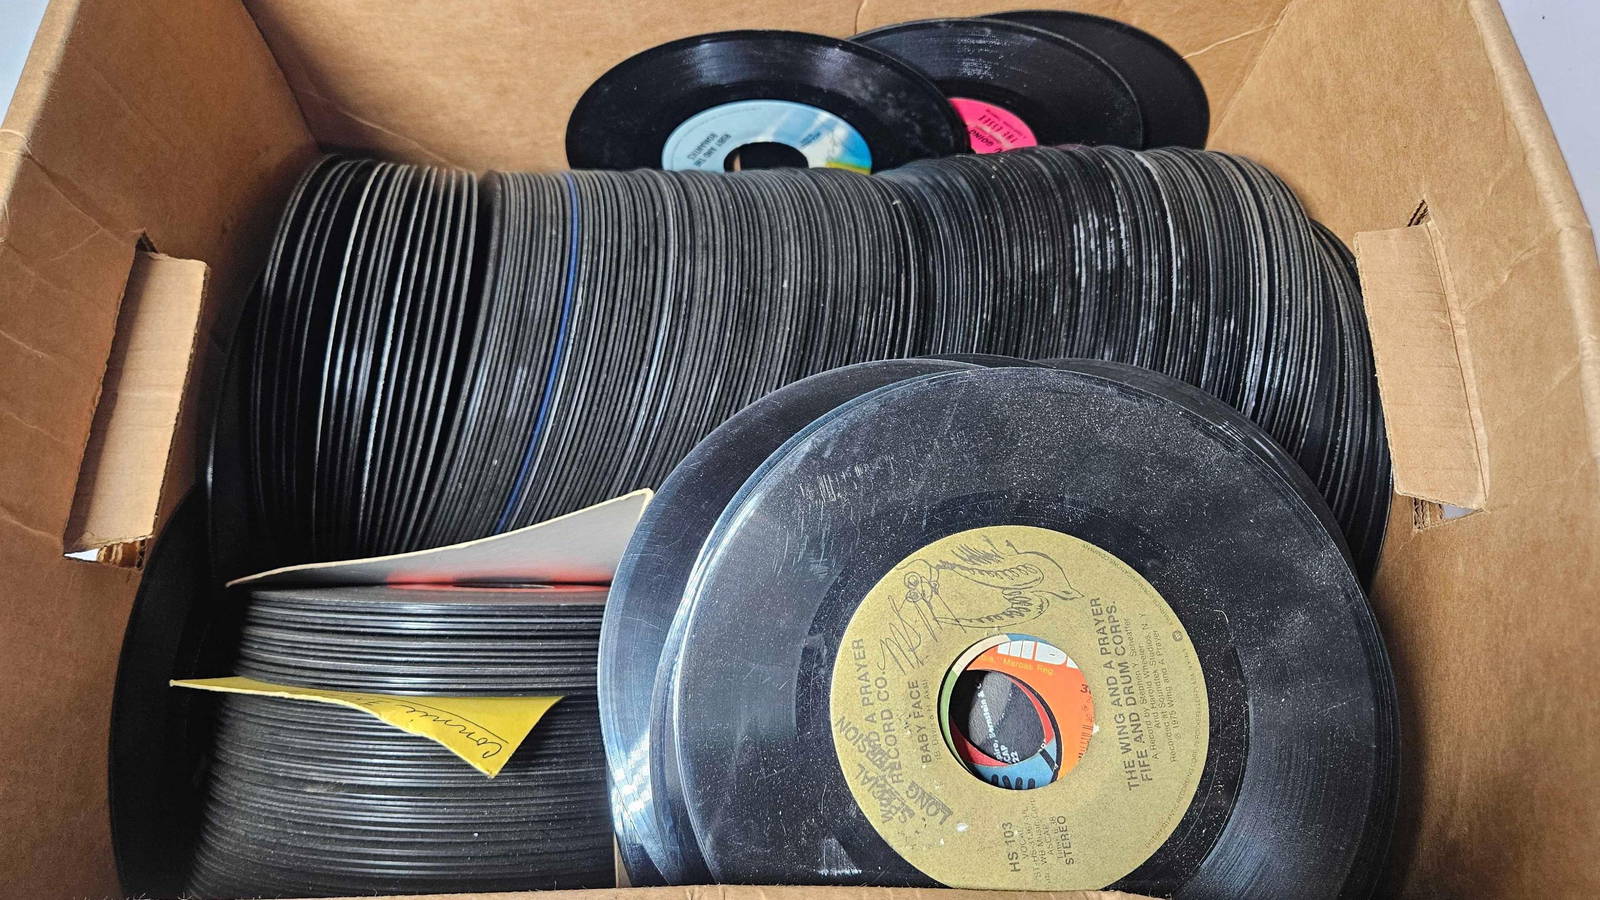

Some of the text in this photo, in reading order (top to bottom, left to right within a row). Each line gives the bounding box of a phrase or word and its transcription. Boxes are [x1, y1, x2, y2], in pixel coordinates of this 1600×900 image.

[1153, 630, 1163, 656] Prayer
[852, 638, 874, 706] PRAYER
[1136, 670, 1148, 705] Stephen
[1152, 670, 1166, 708] Soundtek
[1161, 668, 1170, 683] and
[1090, 597, 1140, 791] THE WING AND A PRAYER
[1106, 600, 1153, 782] FIFE AND DRUM CORPS.
[1145, 681, 1157, 709] Harold
[1166, 686, 1174, 708] Wing
[865, 713, 877, 724] A
[875, 671, 904, 784] RECORD CO.
[907, 680, 932, 763] BABY FACE
[980, 699, 996, 739] Bernstein
[1142, 707, 1151, 717] by
[1152, 712, 1161, 728] And
[1160, 710, 1168, 719] at
[1170, 710, 1179, 729] 1975
[1145, 720, 1157, 750] Record
[1164, 721, 1177, 762] Recorded
[1001, 745, 1011, 763] CAP
[906, 781, 952, 825] LONG
[1002, 822, 1020, 872] HS 103
[1057, 816, 1074, 864] STEREO
